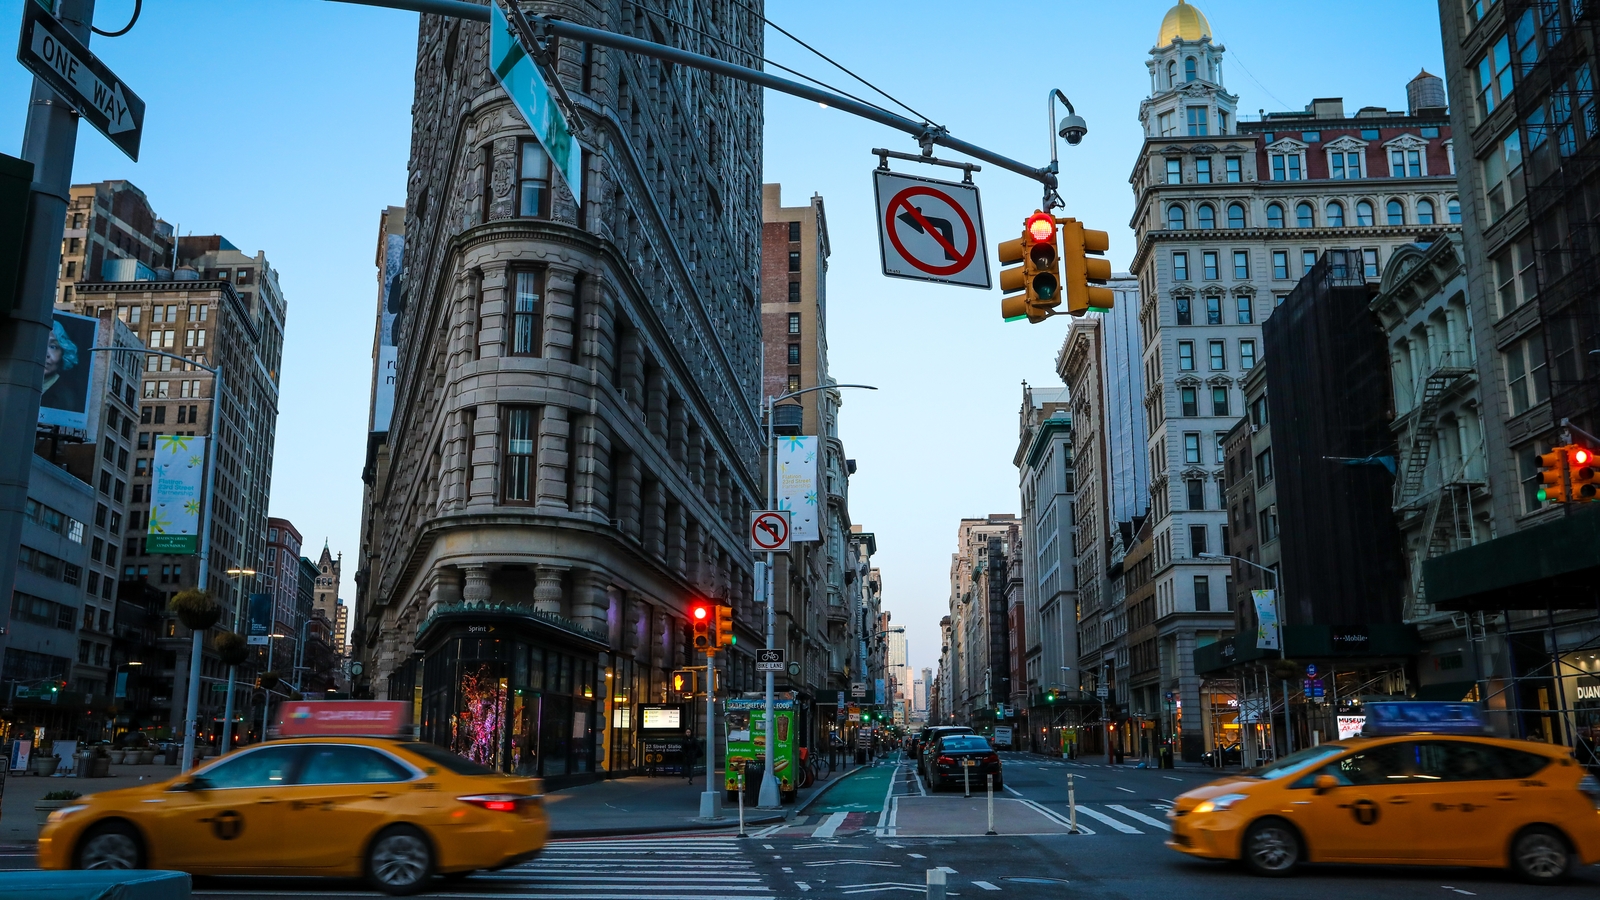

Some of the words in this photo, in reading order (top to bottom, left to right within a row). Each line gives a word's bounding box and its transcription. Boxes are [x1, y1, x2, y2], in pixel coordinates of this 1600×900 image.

[43, 36, 79, 86] ONE
[93, 80, 127, 127] WAY
[530, 77, 538, 116] 5
[468, 625, 487, 633] Sprint
[1577, 685, 1600, 699] DUAN
